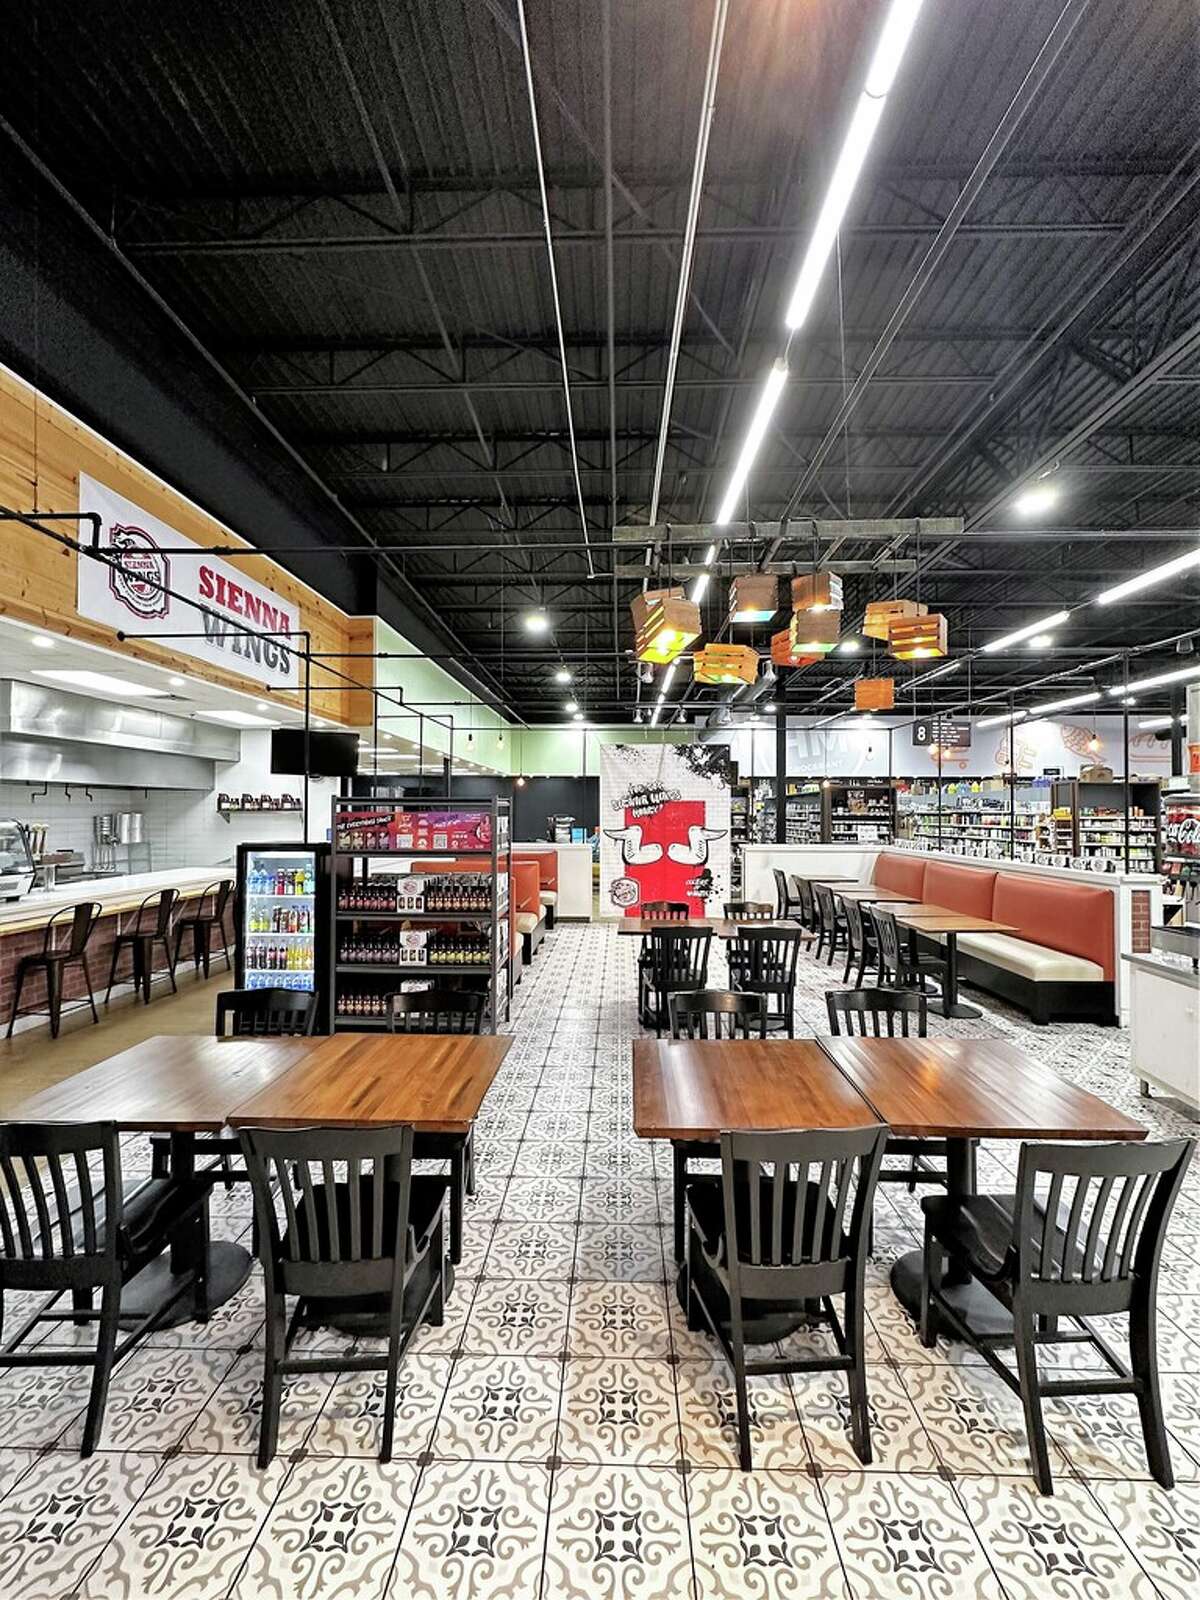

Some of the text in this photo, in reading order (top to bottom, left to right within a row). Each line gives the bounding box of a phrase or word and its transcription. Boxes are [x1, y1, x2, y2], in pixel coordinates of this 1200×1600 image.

[123, 571, 161, 583] WNGS
[199, 565, 292, 640] SIENNA
[199, 603, 291, 675] WINGS
[918, 725, 926, 741] 8
